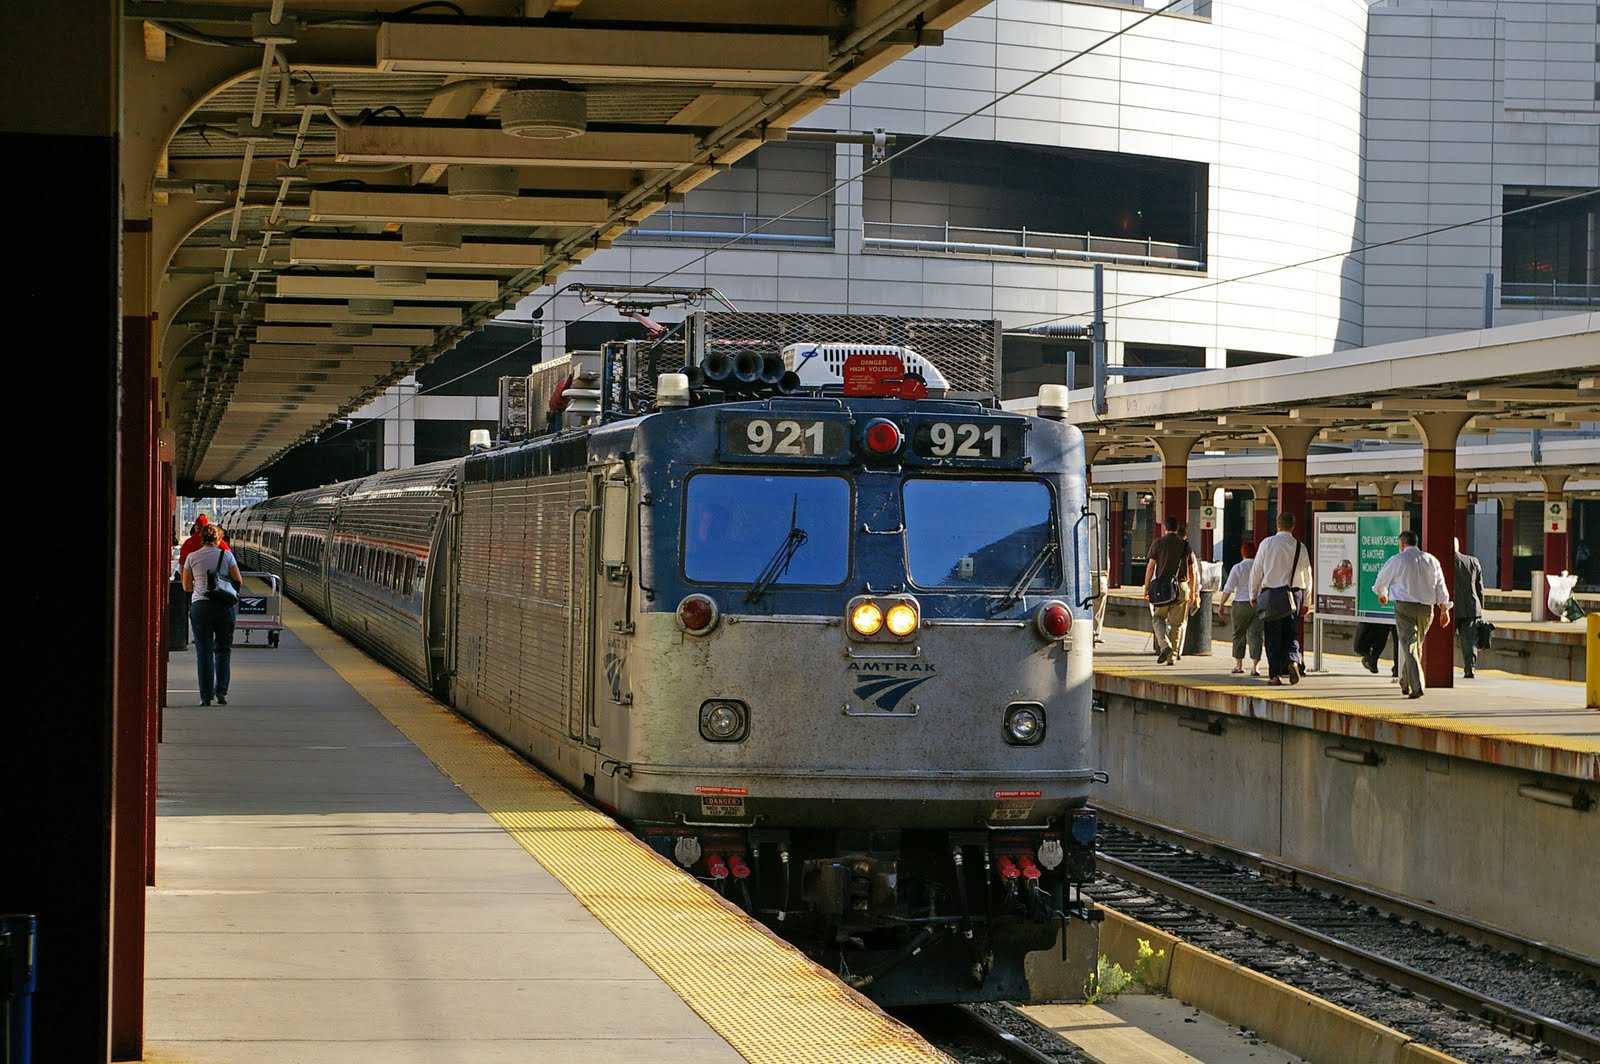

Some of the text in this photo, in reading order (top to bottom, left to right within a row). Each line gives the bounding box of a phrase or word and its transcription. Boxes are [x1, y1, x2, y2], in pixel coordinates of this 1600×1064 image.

[746, 420, 824, 455] 921
[930, 422, 1001, 458] 921
[1361, 535, 1371, 546] ONE
[1361, 549, 1385, 559] IS ANOTHER
[848, 662, 936, 672] AMTRAK
